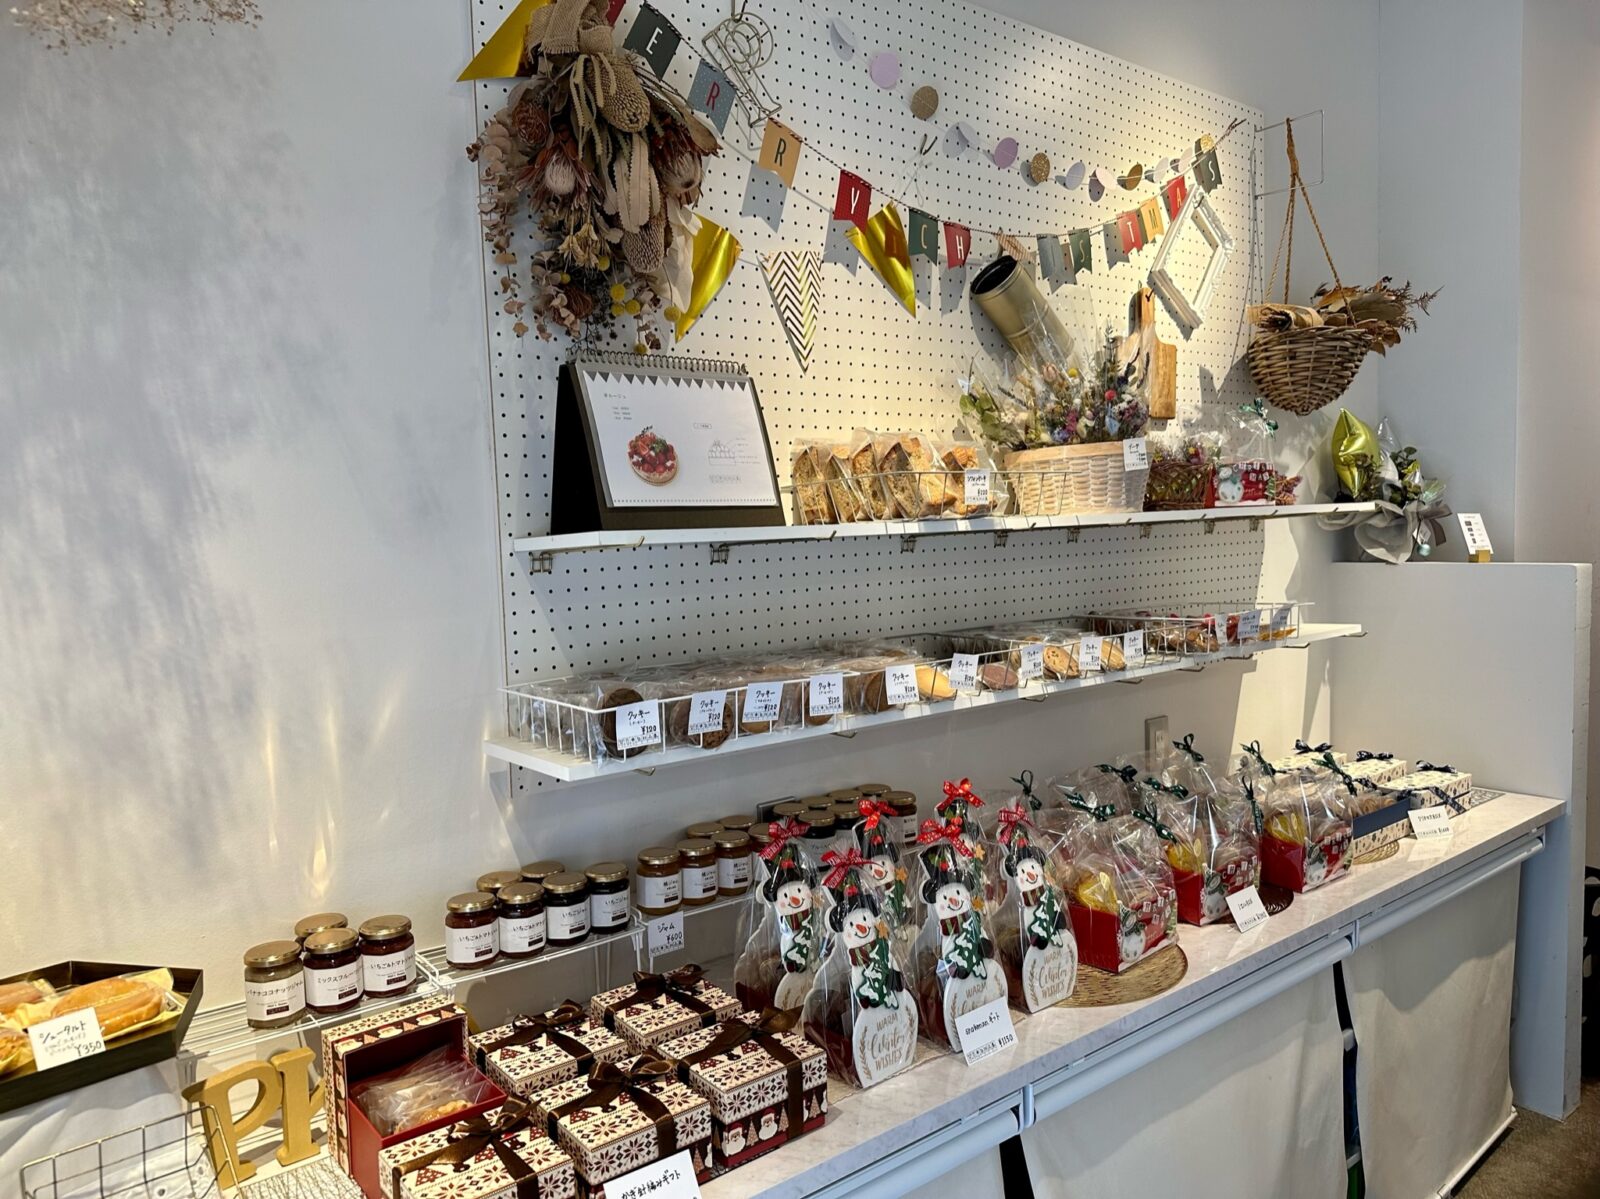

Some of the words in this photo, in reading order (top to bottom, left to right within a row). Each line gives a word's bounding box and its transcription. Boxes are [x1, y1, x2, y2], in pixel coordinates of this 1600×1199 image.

[892, 673, 909, 682] クッキー
[818, 681, 836, 690] クッキー
[756, 690, 775, 698] クッキー
[700, 699, 719, 709] クッキー
[764, 704, 777, 712] ¥120
[628, 710, 650, 720] クッキー
[708, 713, 720, 722] ¥120
[641, 725, 657, 735] ¥120
[657, 922, 675, 933] ジャム
[666, 930, 682, 944] ¥600
[966, 982, 987, 998] WARM
[876, 1012, 898, 1032] WARM
[998, 1034, 1014, 1047] ¥1150
[875, 1047, 902, 1070] WISHES
[621, 1169, 681, 1199] かぎ針編みギフト
